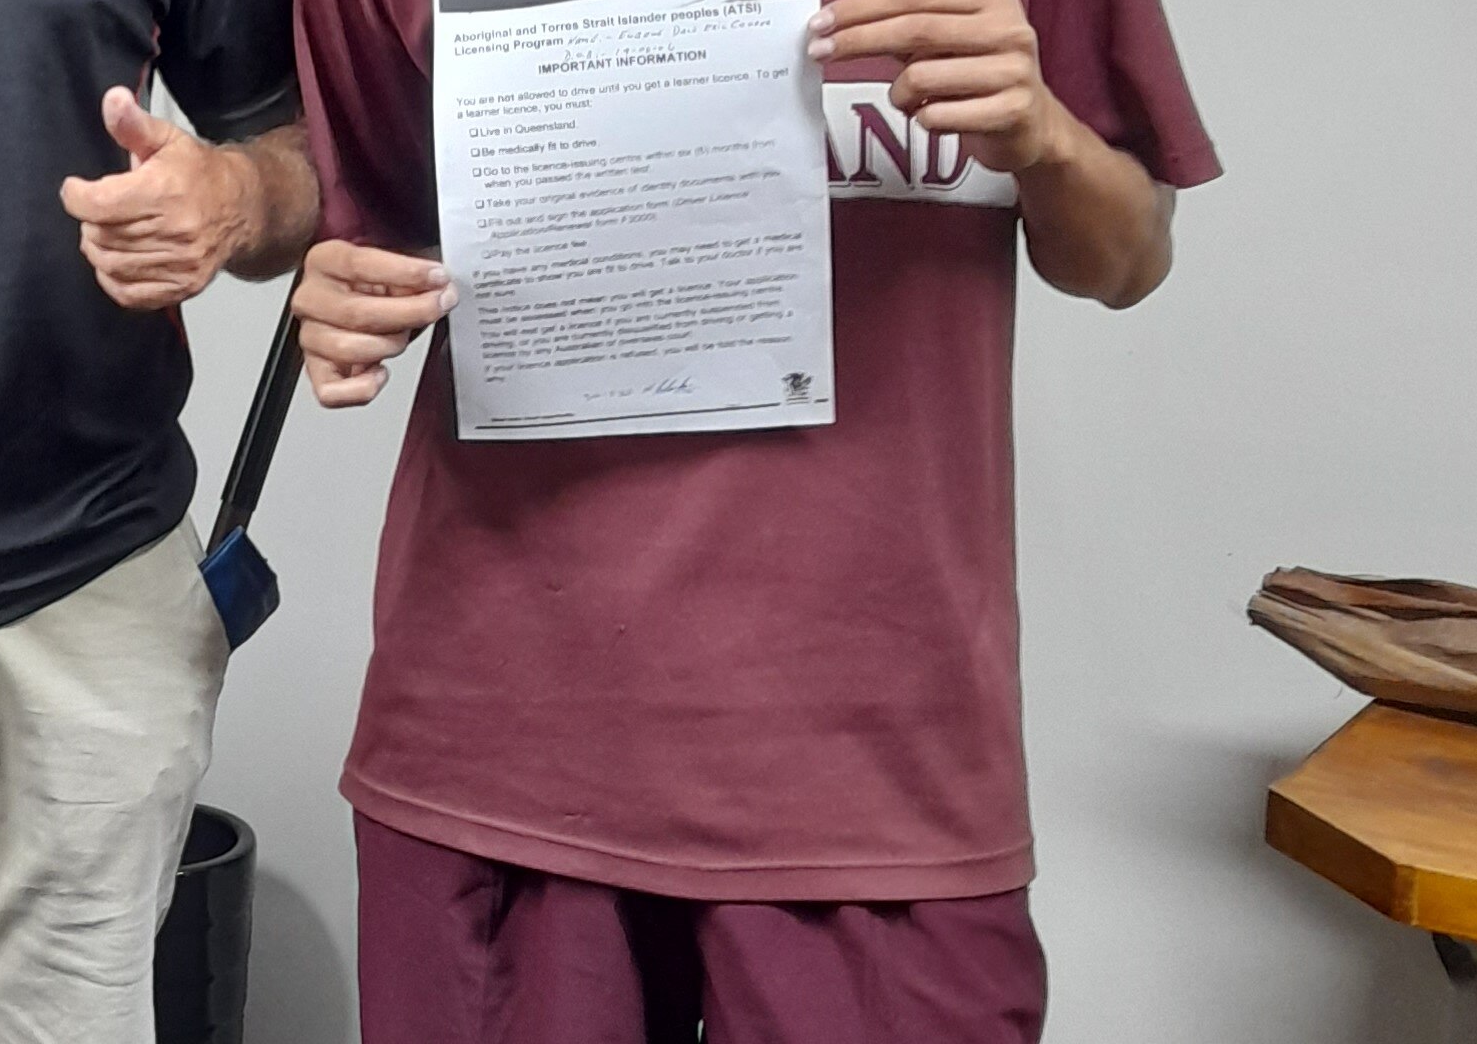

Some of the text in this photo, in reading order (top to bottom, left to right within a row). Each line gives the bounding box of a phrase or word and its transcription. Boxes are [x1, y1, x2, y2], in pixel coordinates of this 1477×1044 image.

[454, 3, 762, 44] Aboriginal and Torres Strait Islander peoples (ATSI)
[454, 37, 564, 56] Licensing Program
[538, 57, 612, 74] IMPORTANT
[616, 50, 707, 67] INFORMATION
[457, 97, 476, 107] You
[479, 97, 495, 105] are
[498, 94, 515, 103] not
[518, 89, 556, 101] allowed
[559, 88, 568, 97] to
[571, 85, 596, 96] drive
[599, 82, 620, 94] until
[623, 82, 642, 93] you
[645, 80, 665, 91] get
[674, 76, 709, 87] learner
[756, 69, 770, 79] To
[772, 67, 789, 79] get
[457, 111, 463, 119] a
[466, 107, 500, 118] learner
[544, 103, 563, 113] you
[480, 128, 501, 137] Live
[503, 127, 512, 135] in
[482, 148, 495, 157] Be
[498, 143, 545, 155] medically
[548, 142, 557, 151] fit
[559, 140, 569, 149] to
[483, 167, 498, 176] Go
[501, 167, 511, 175] to
[514, 165, 529, 174] the
